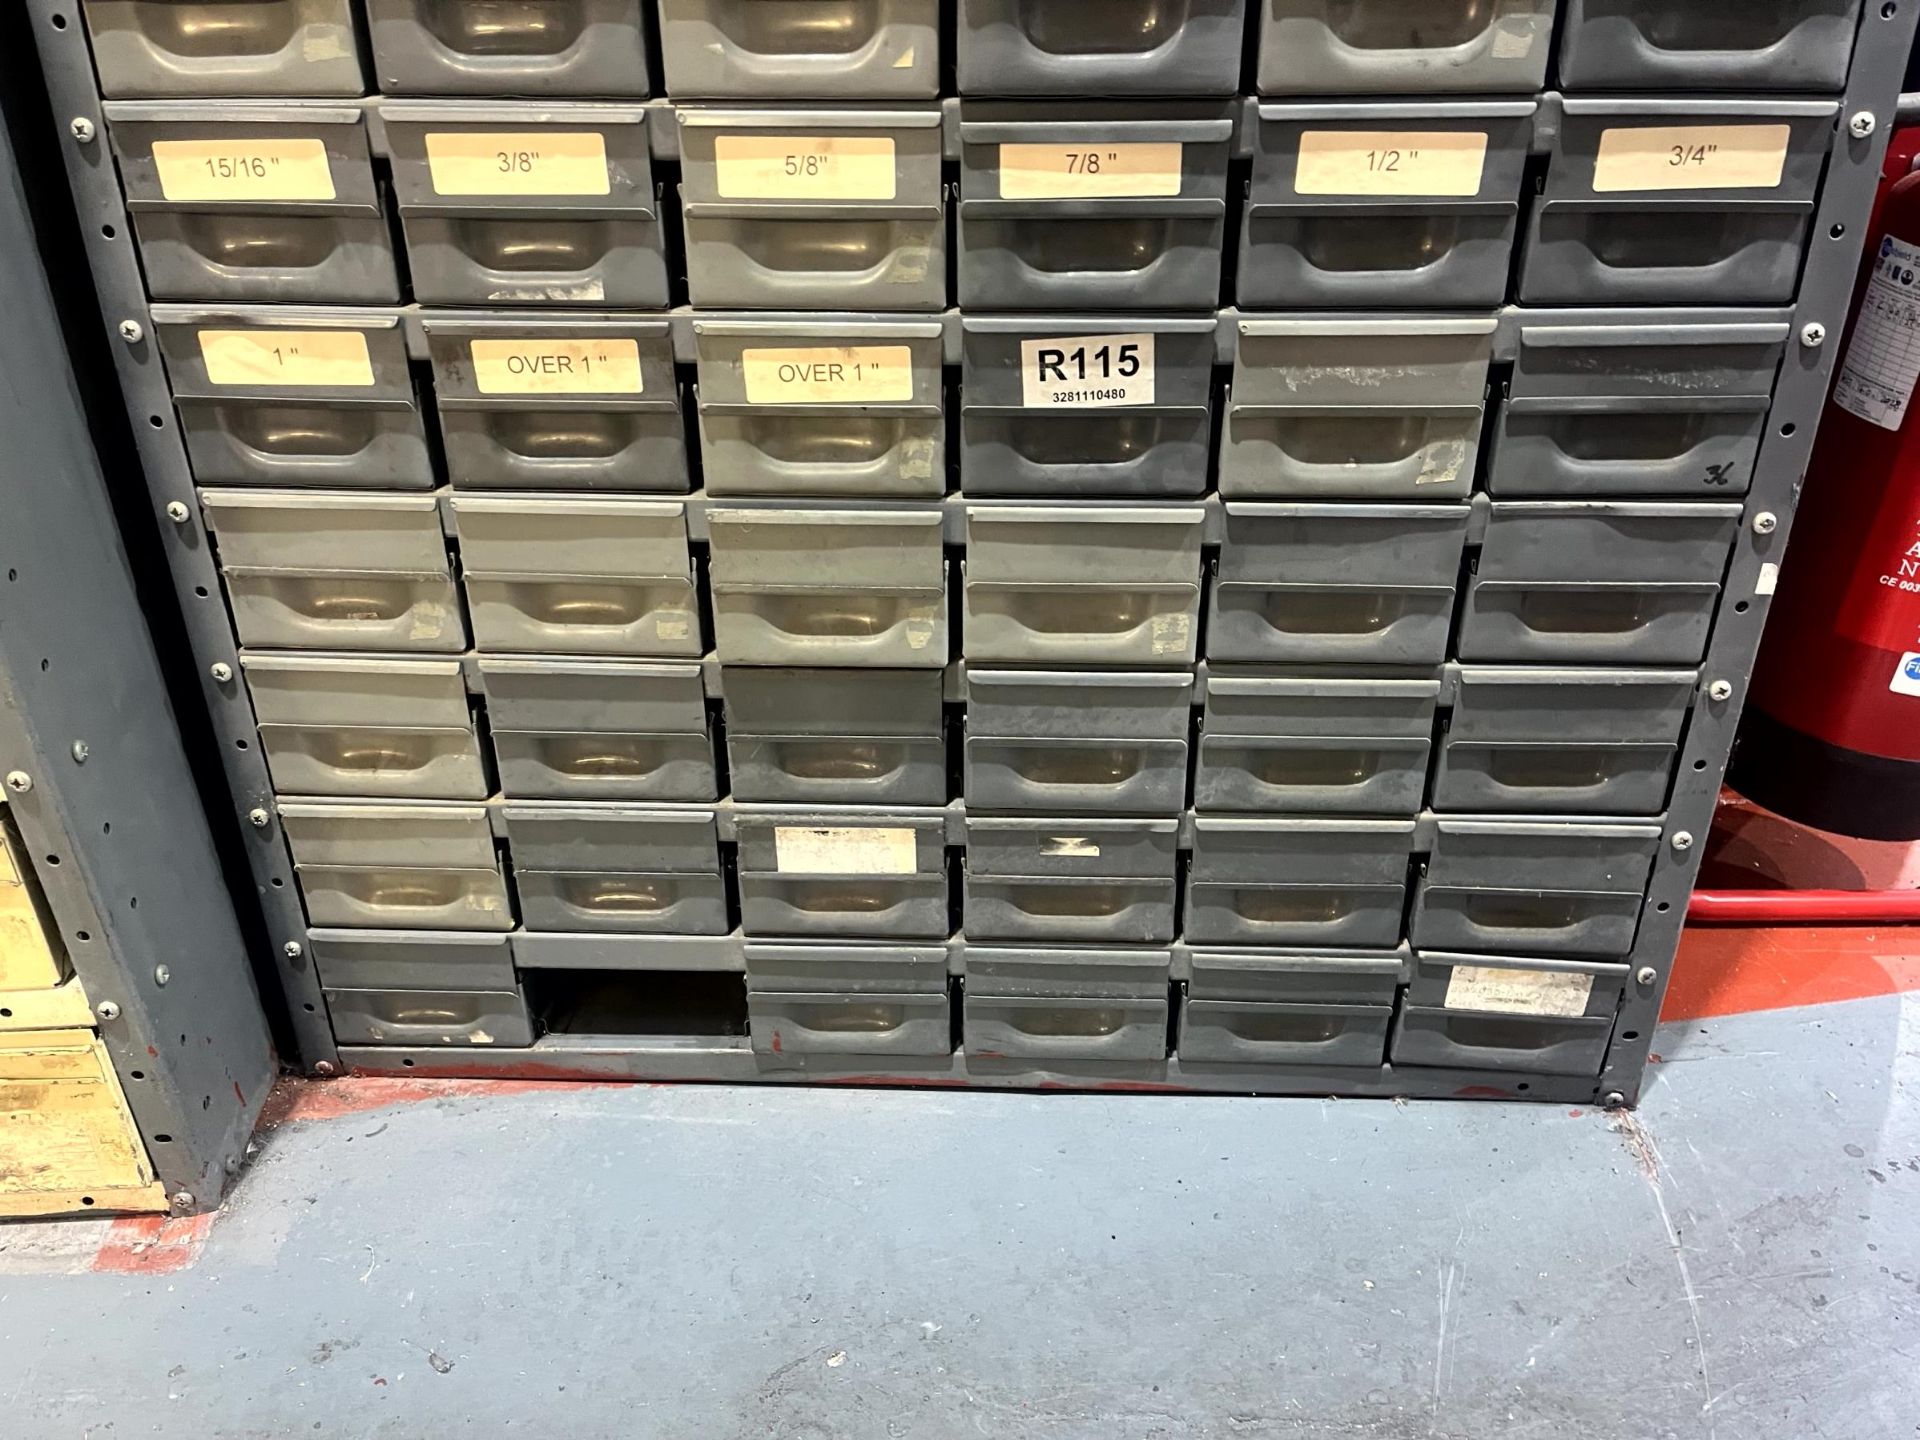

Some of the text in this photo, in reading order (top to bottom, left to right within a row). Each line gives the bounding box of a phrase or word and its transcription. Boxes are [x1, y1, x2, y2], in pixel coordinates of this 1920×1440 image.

[497, 151, 540, 173] 3/8"
[785, 155, 828, 176] 5/8"
[1668, 144, 1718, 167] 3/4"
[507, 355, 574, 375] OVER
[778, 363, 845, 383] OVER
[1037, 343, 1140, 383] R115
[1052, 388, 1126, 403] 3281110480
[1879, 574, 1920, 593] CE 003
